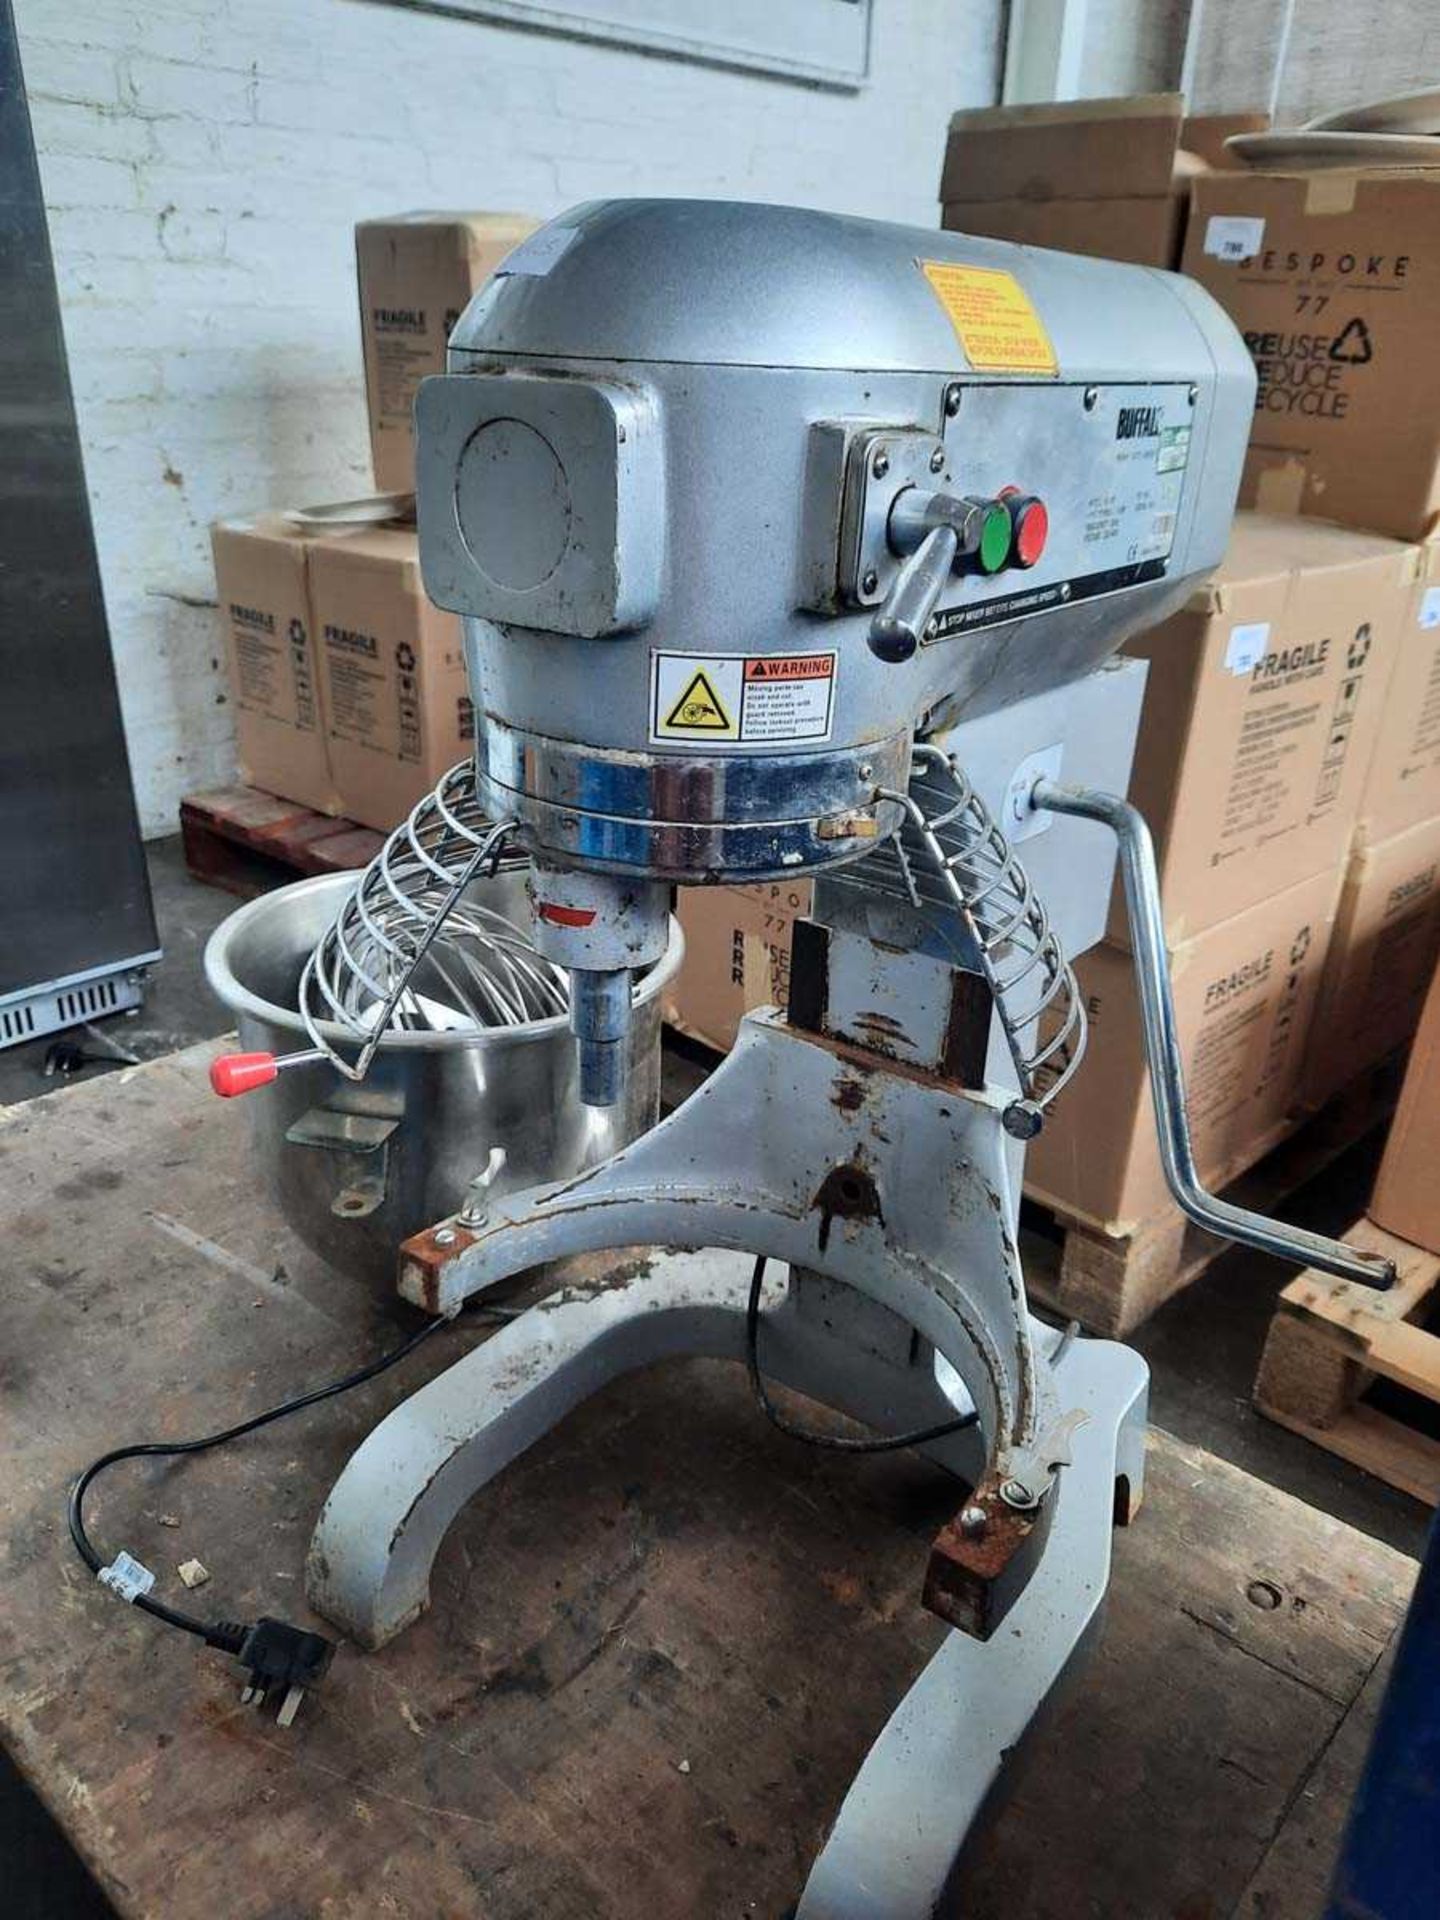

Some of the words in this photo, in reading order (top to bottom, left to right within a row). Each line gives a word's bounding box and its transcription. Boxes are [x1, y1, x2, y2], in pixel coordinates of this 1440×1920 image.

[1295, 296, 1330, 316] 77
[1257, 359, 1344, 391] EDUCE
[1254, 384, 1350, 418] ECYCLE
[768, 660, 830, 676] WARNING
[1252, 638, 1331, 681] FRAGILE
